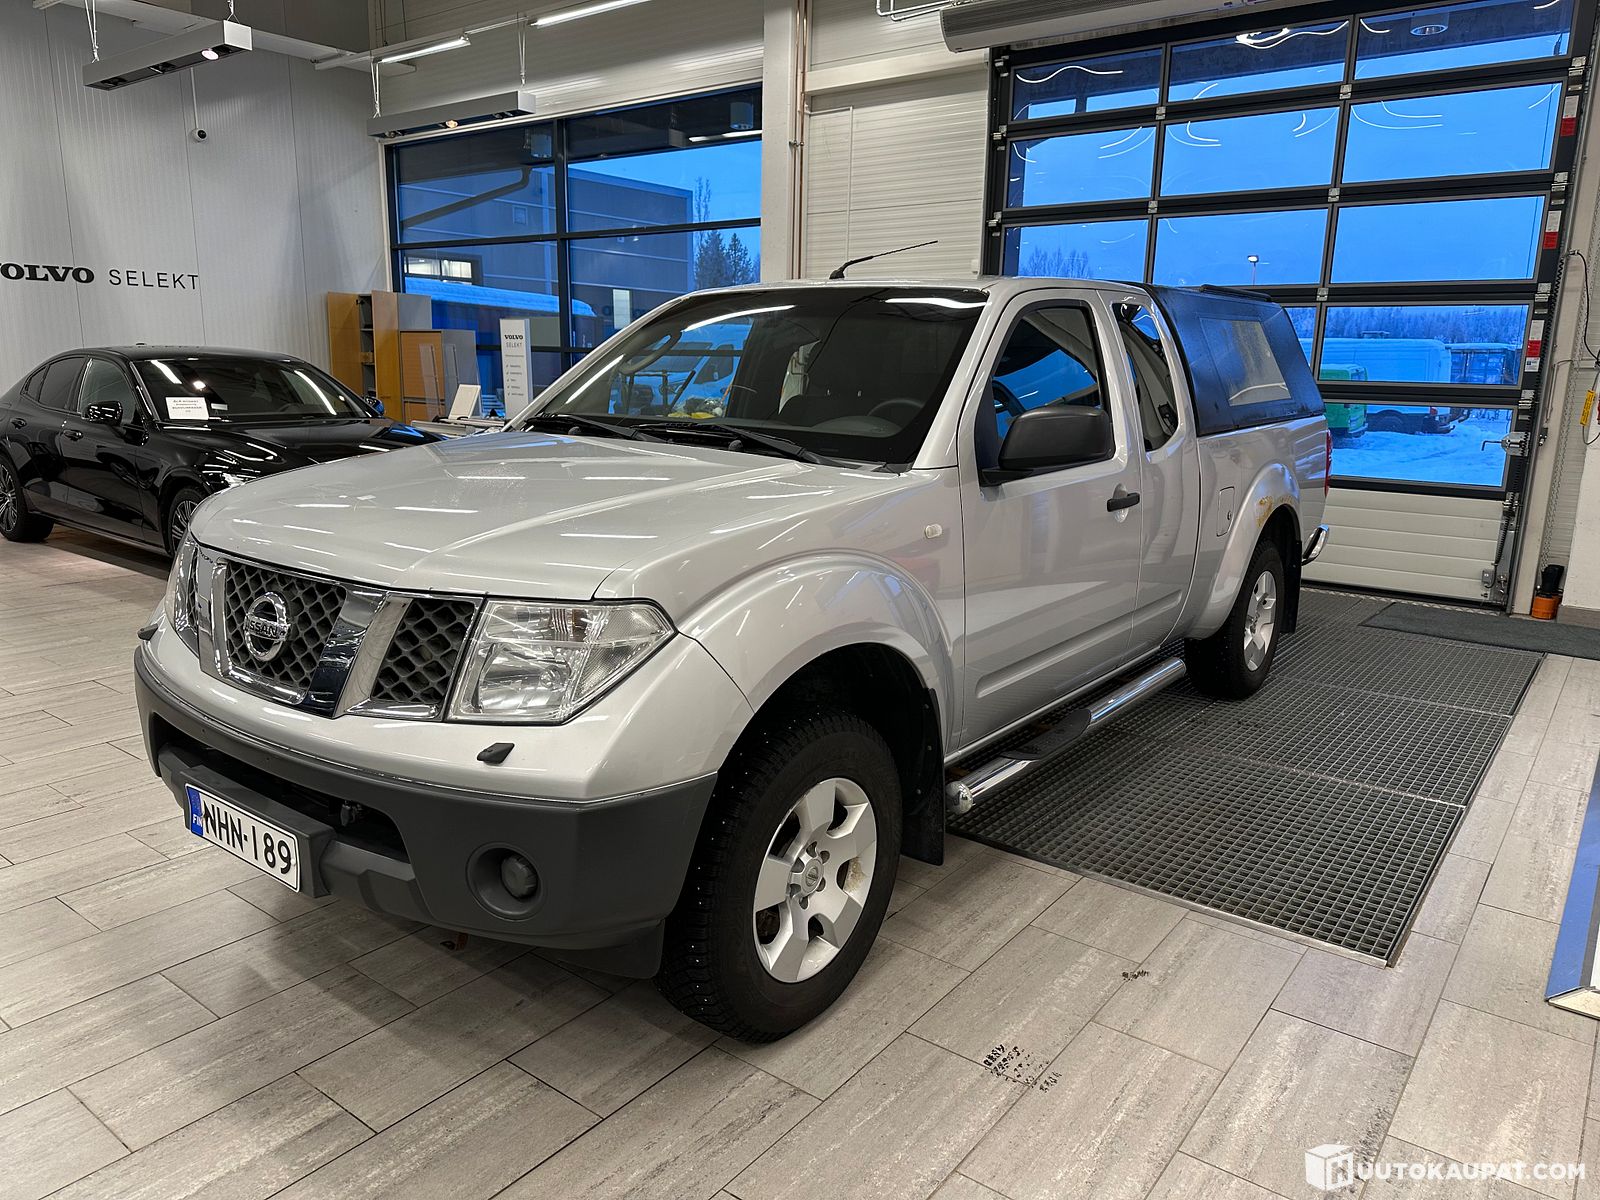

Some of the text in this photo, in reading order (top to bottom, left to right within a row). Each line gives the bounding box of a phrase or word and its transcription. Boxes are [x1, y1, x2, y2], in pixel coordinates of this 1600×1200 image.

[0, 262, 199, 290] OLVO SELEKT
[245, 619, 279, 639] SSAN
[203, 800, 292, 875] NHN-189
